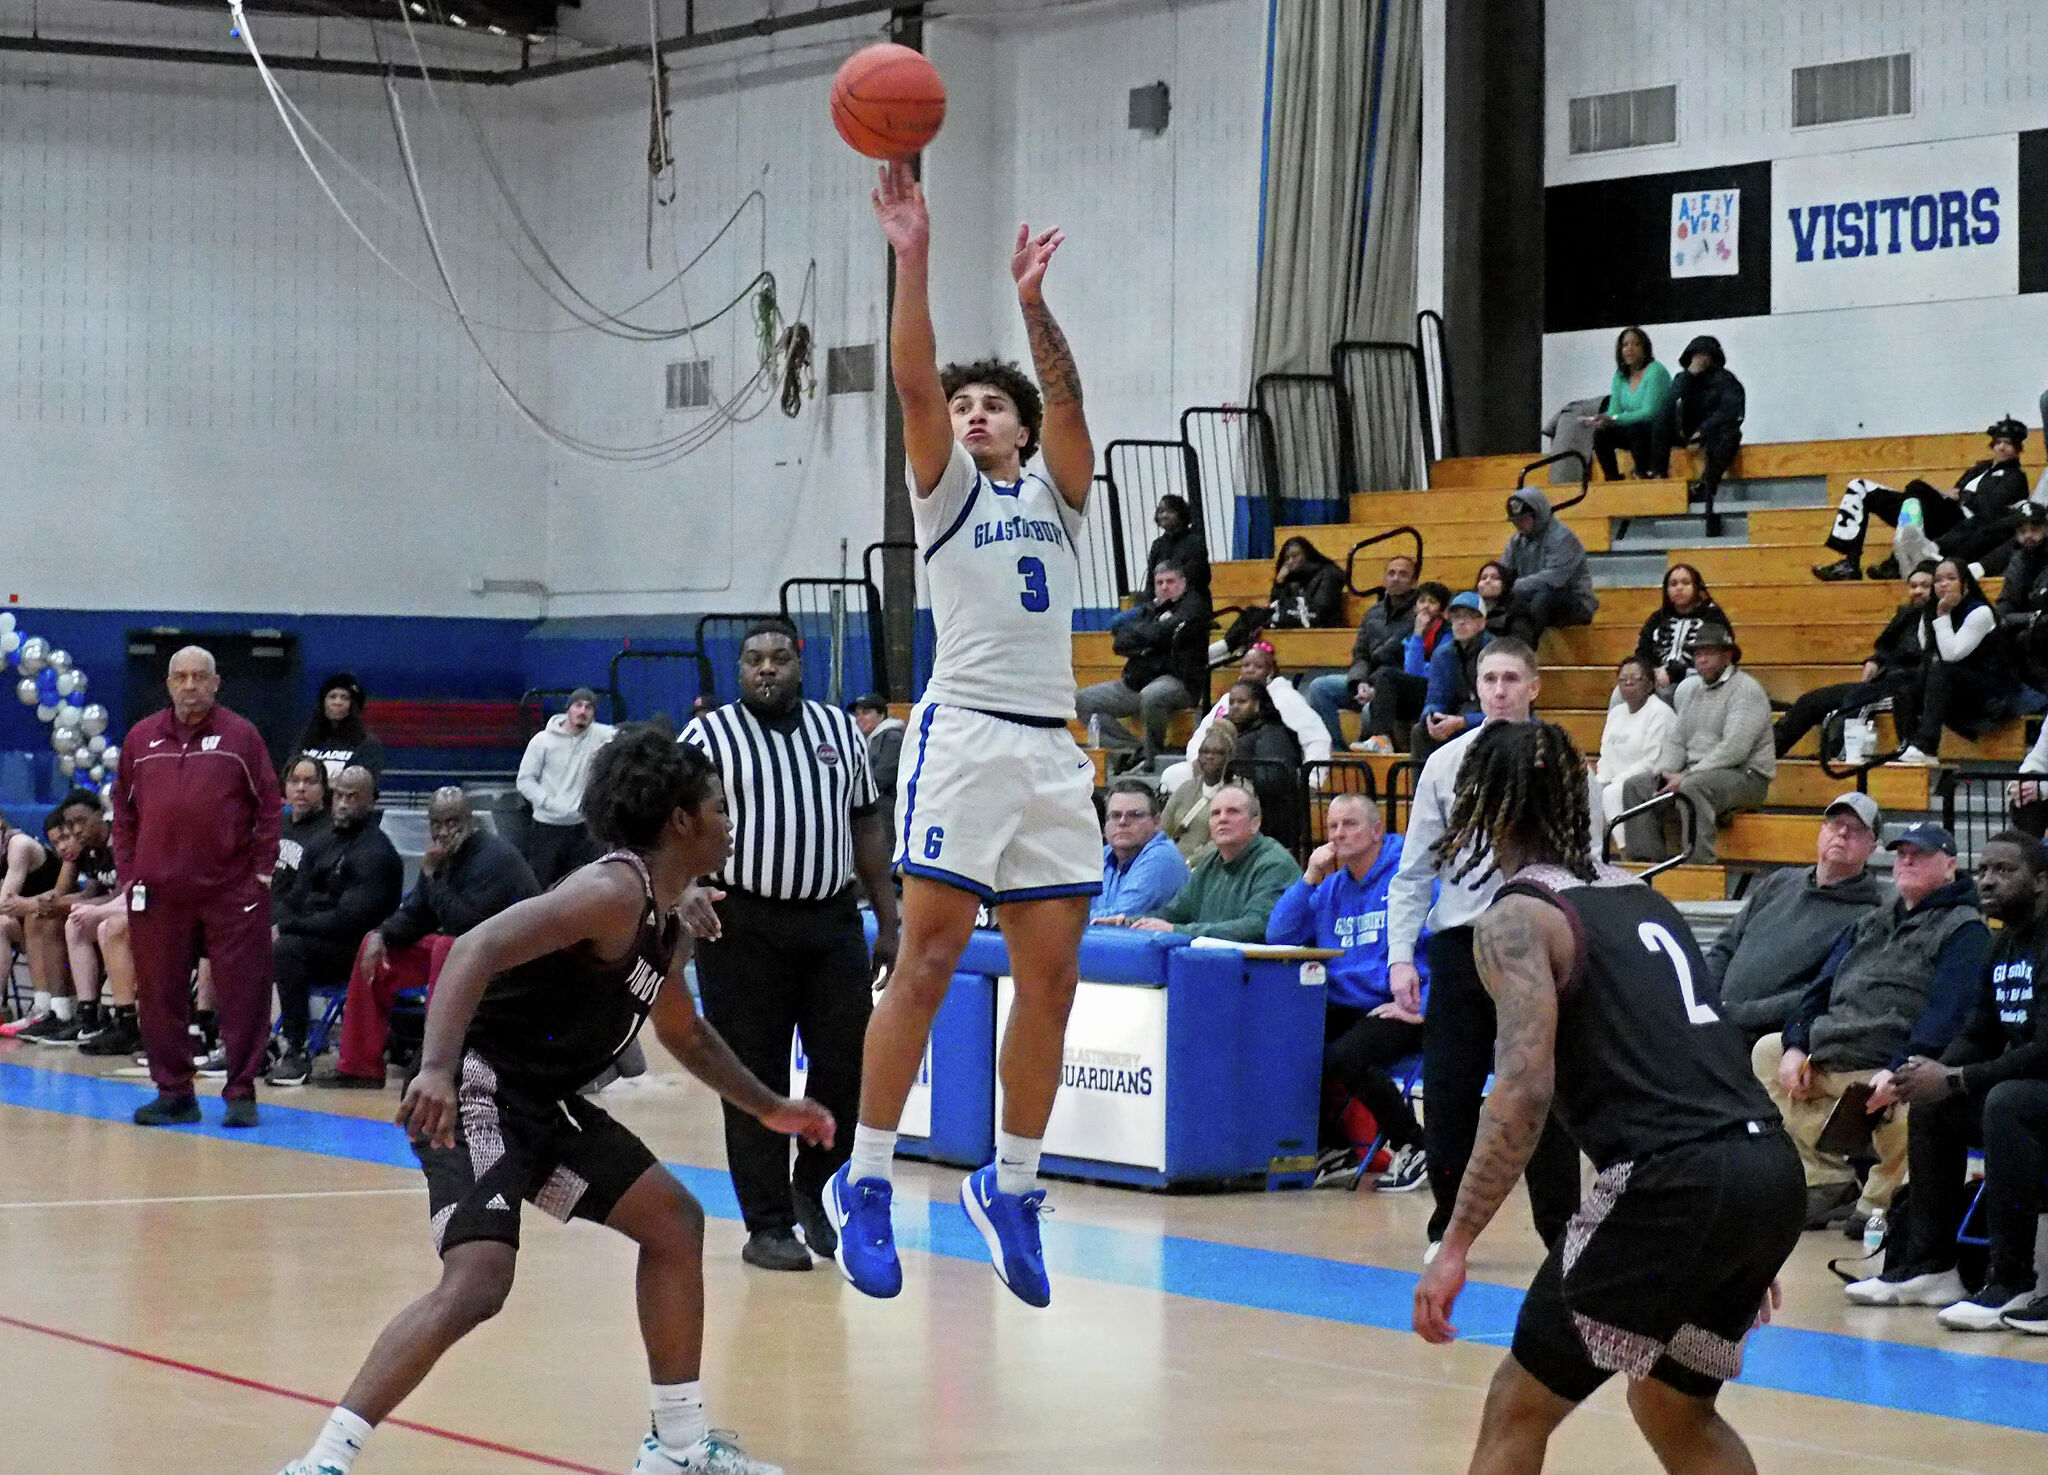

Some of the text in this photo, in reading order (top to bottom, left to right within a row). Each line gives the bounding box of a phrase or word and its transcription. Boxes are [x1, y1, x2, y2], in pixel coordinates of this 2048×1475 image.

[1788, 187, 1999, 262] VISITORS
[1017, 556, 1050, 613] 3
[1638, 922, 1720, 1024] 2
[1063, 1065, 1152, 1096] UARDIANS
